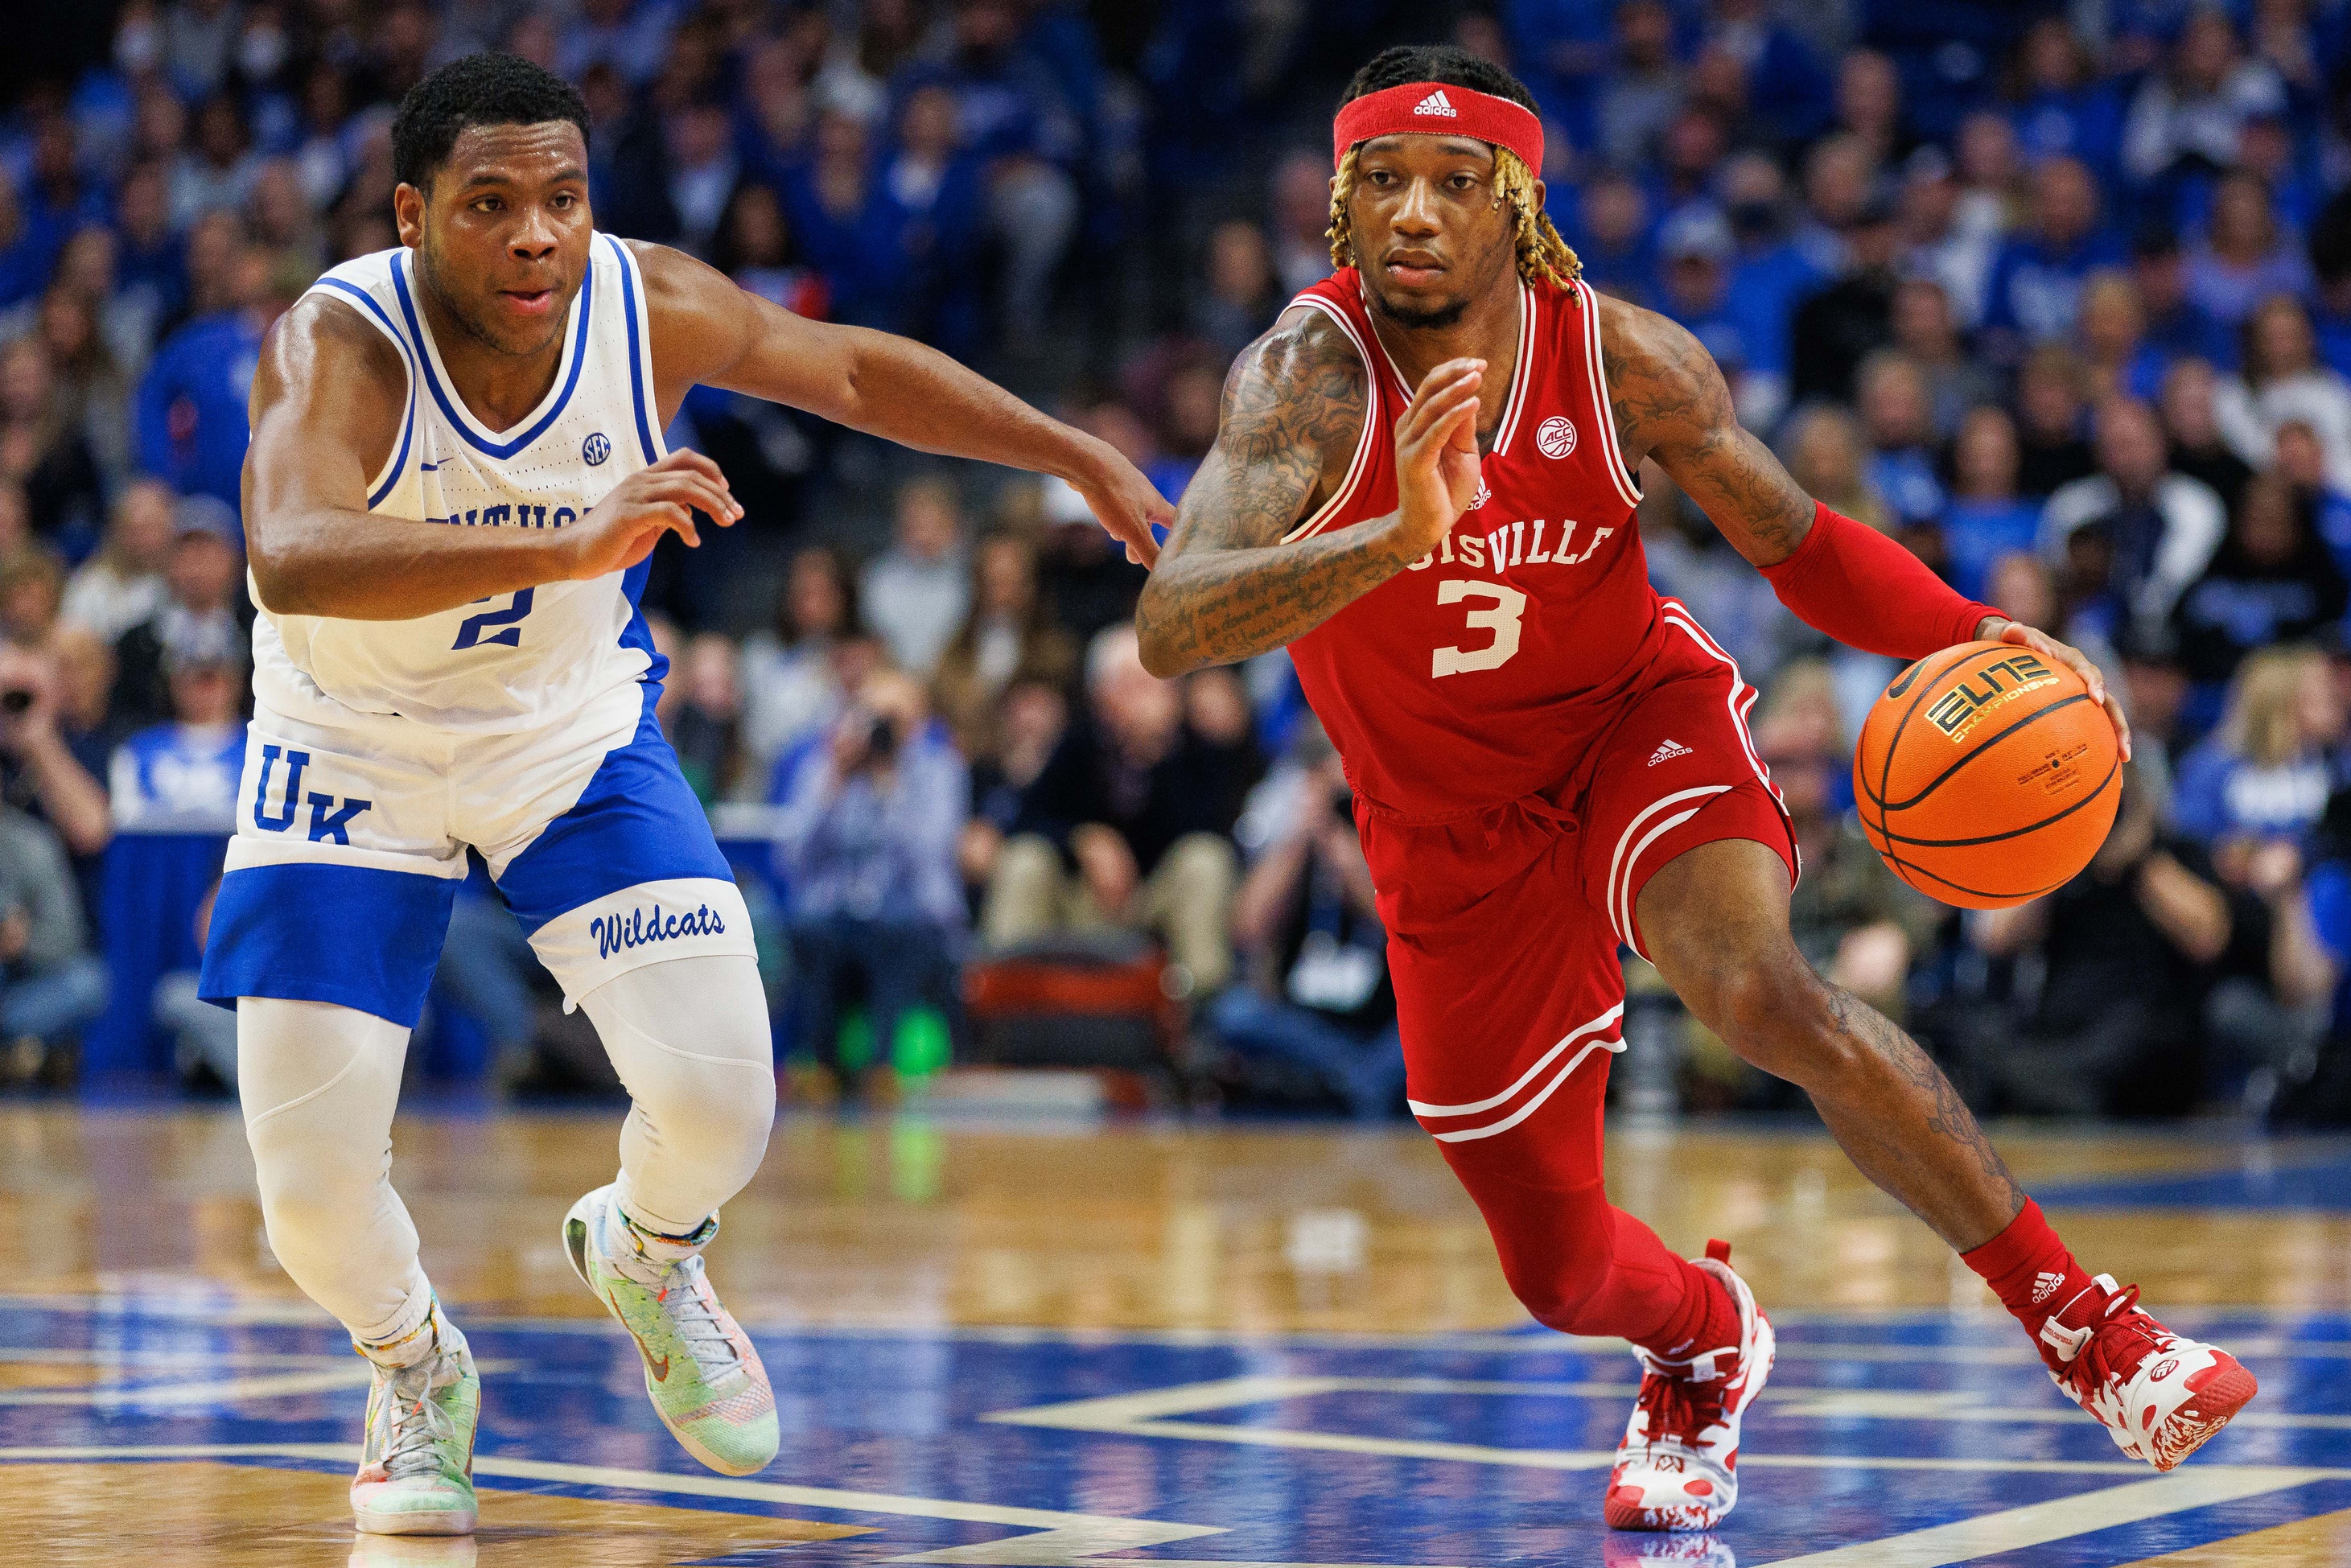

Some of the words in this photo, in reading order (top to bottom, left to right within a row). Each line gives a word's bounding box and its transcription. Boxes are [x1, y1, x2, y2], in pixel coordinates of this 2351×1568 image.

[1414, 105, 1457, 118] adidas
[584, 434, 610, 465] SEC
[1544, 426, 1572, 444] ACC
[1466, 489, 1492, 511] adias
[451, 586, 535, 650] 2
[1432, 579, 1527, 679] 3
[1924, 654, 2054, 736] ELITE
[1951, 677, 2061, 743] CHAMPIONSHIP
[1648, 747, 1694, 767] adidas
[253, 744, 372, 846] UK
[591, 904, 725, 960] Wildcats
[2032, 1272, 2065, 1303] adidas
